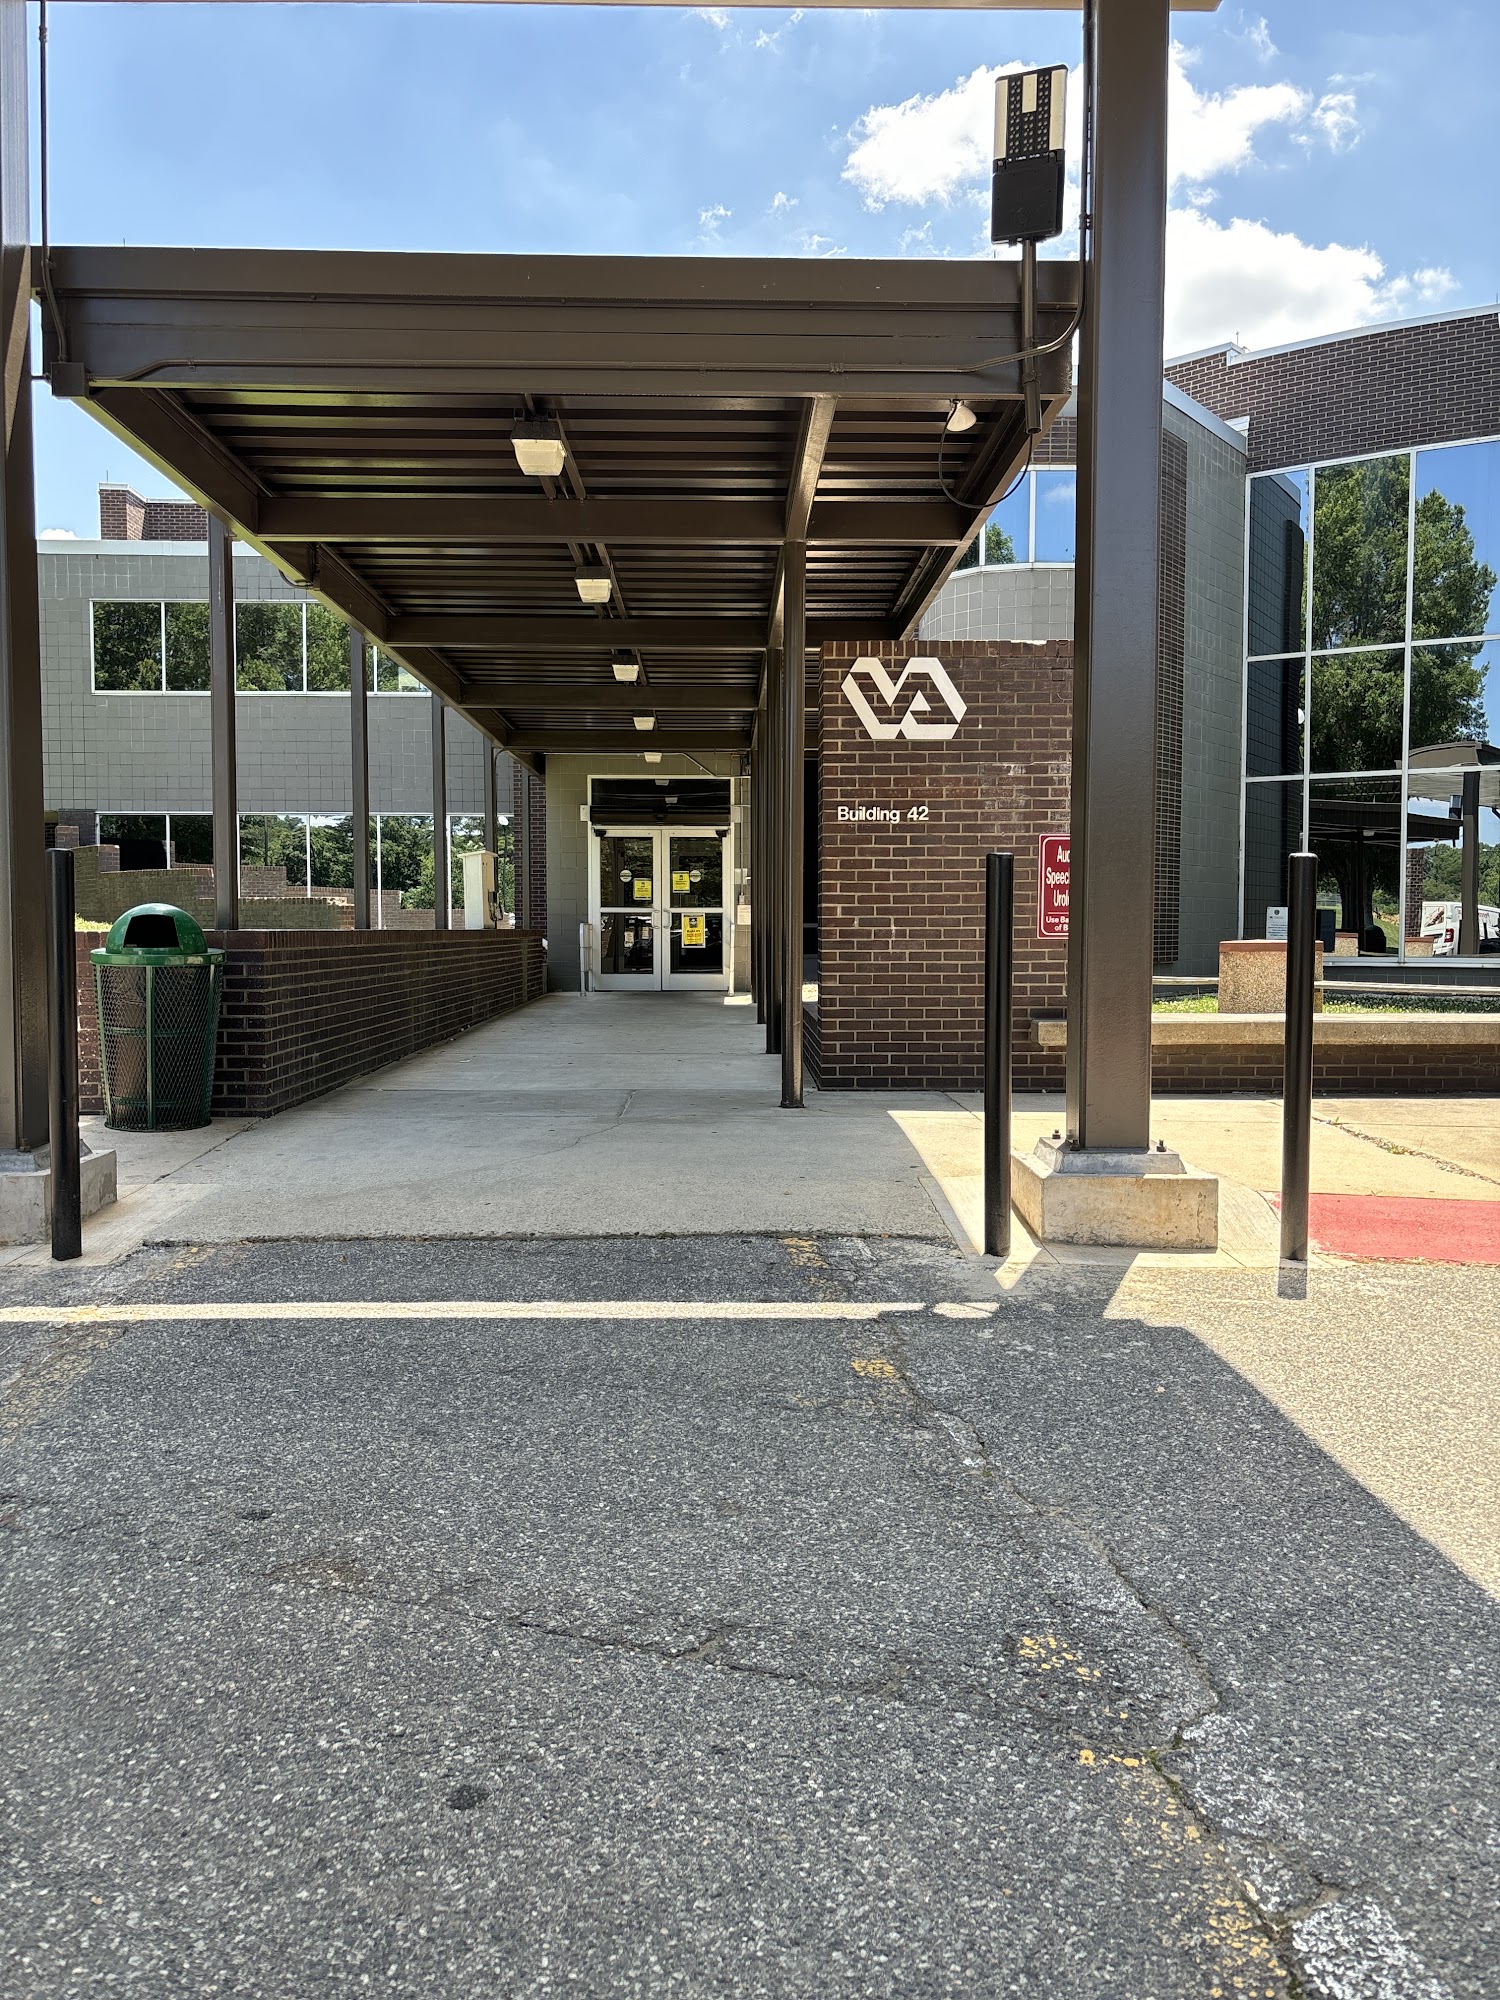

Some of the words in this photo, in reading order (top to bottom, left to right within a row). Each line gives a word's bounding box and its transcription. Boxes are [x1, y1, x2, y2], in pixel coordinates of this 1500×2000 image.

[837, 806, 900, 823] Building
[906, 806, 929, 821] 42
[1045, 915, 1059, 923] Use
